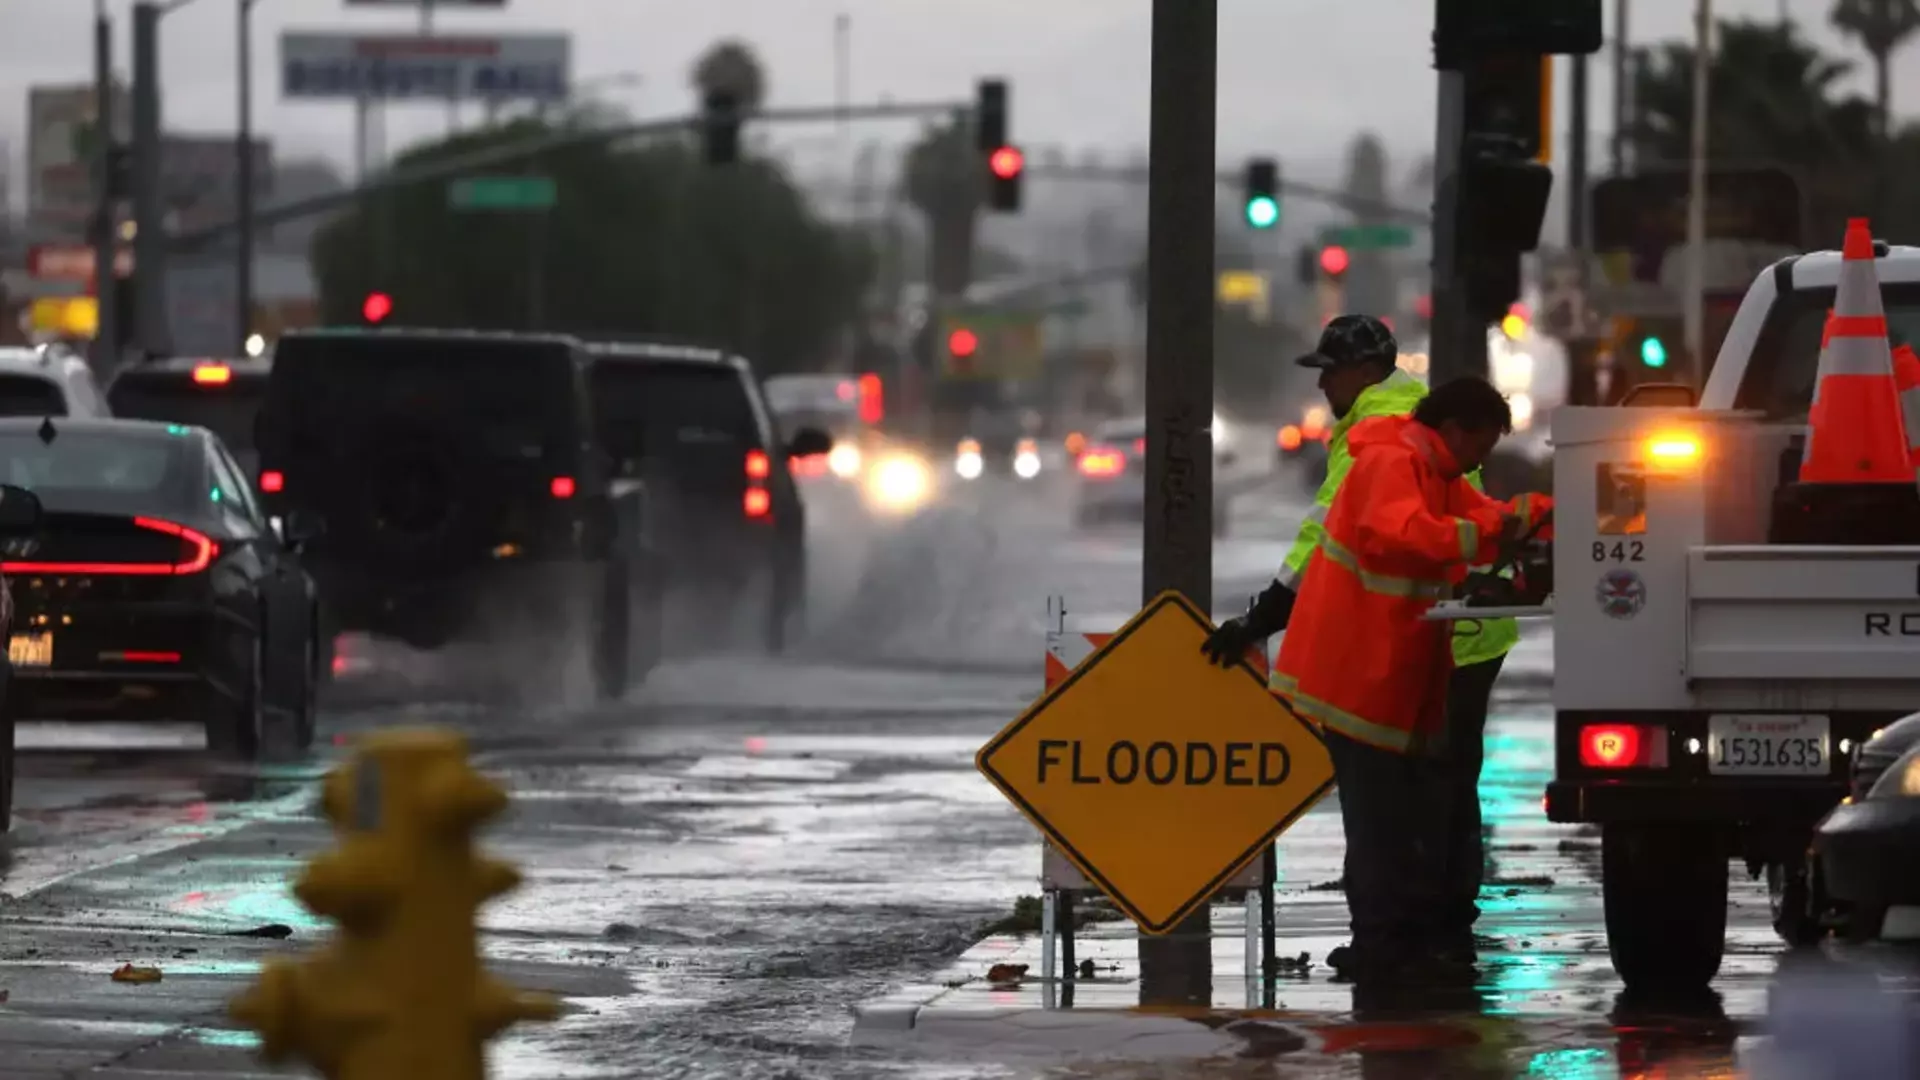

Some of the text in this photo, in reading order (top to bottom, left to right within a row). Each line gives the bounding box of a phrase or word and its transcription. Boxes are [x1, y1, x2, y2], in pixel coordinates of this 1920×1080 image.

[1592, 540, 1646, 563] 842
[1037, 739, 1291, 787] FLOODED
[1718, 737, 1822, 767] 1531635
